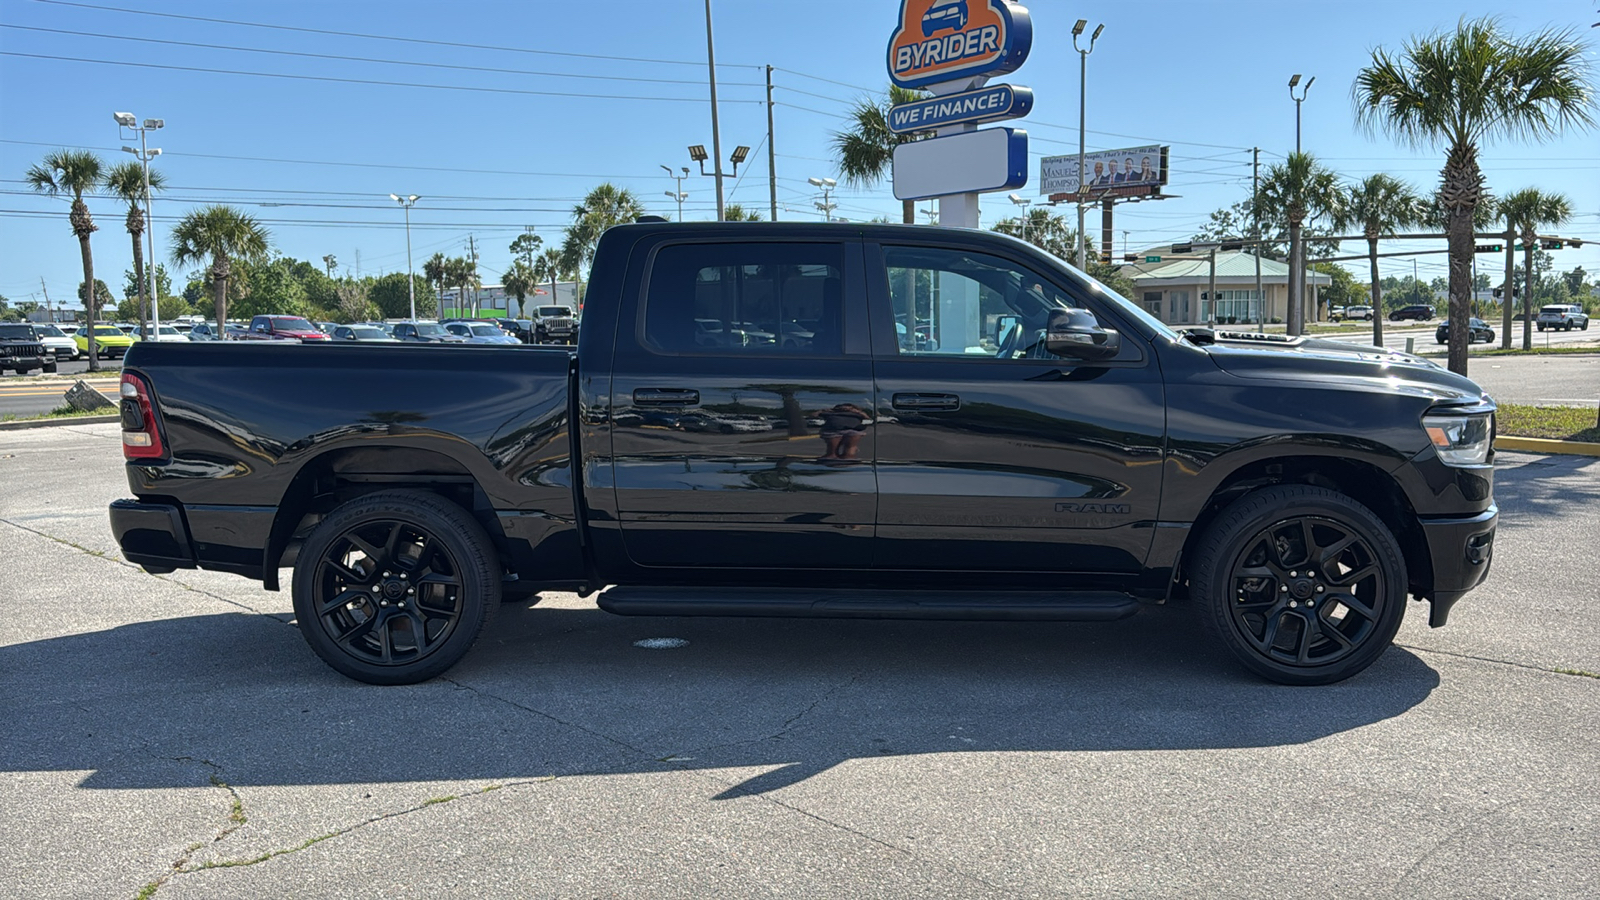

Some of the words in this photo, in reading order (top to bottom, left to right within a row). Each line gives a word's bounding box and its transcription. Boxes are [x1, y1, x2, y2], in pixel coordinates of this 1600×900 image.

[896, 26, 998, 71] BYRIDER
[894, 108, 920, 125] WE
[922, 92, 1006, 120] FINANCE!
[1043, 167, 1072, 177] MANUEL
[1043, 178, 1080, 188] THOMPSON
[1054, 502, 1131, 514] RAM
